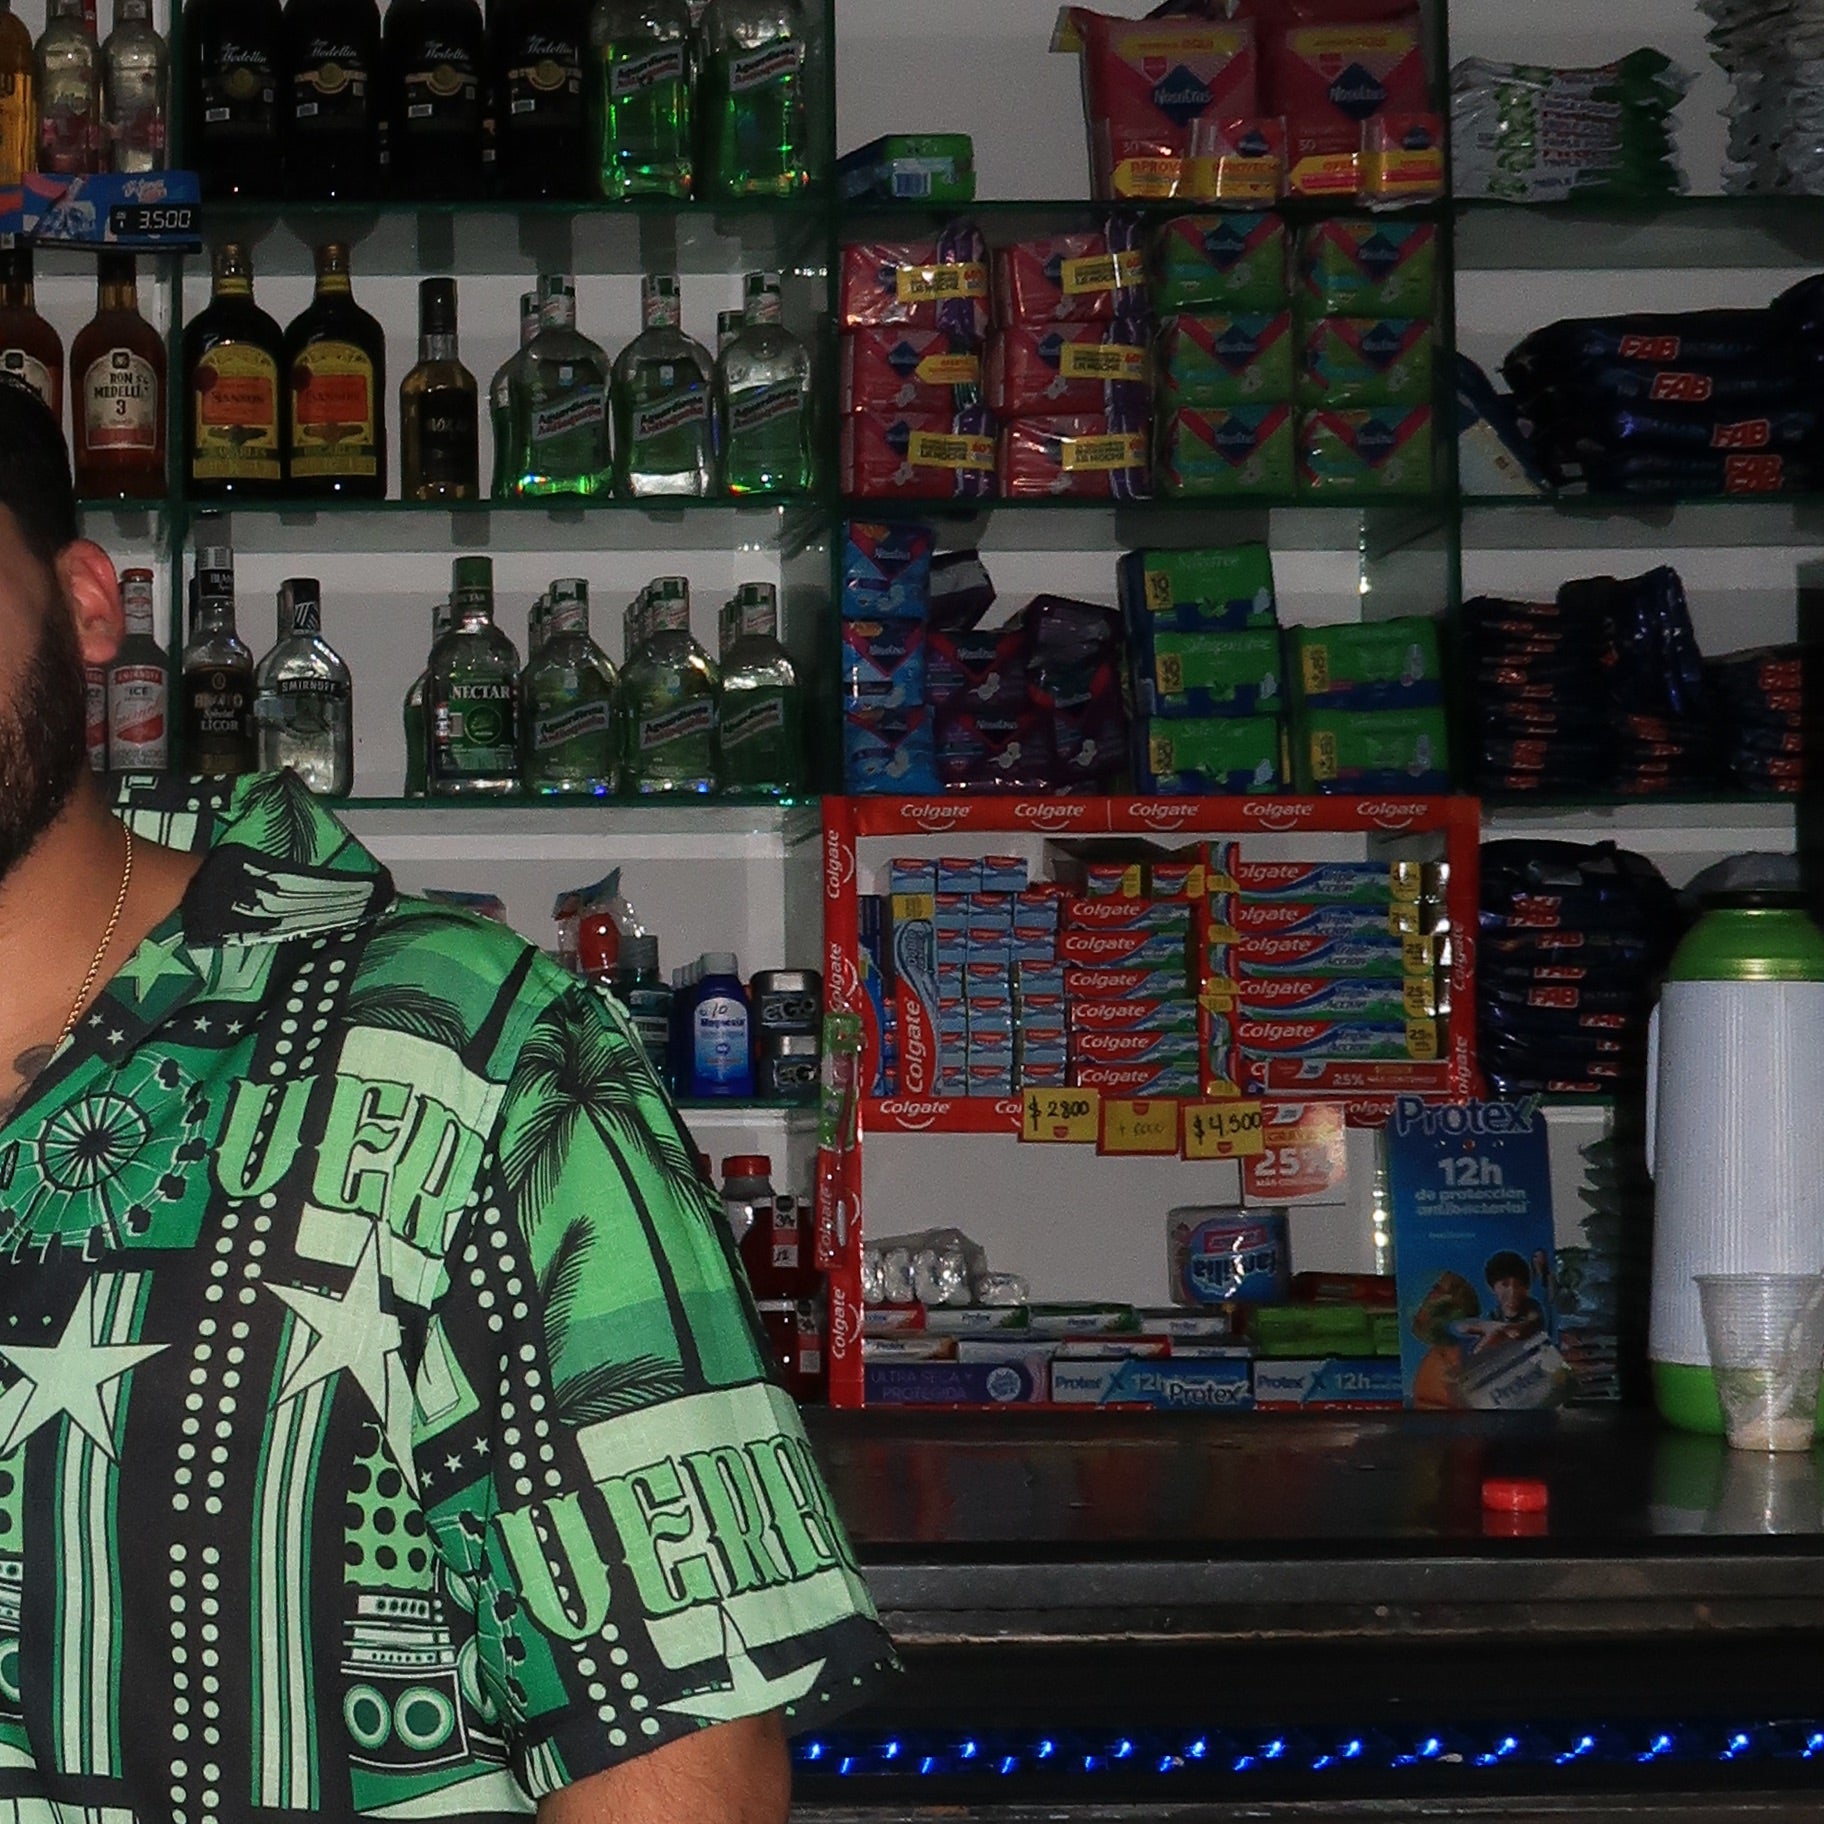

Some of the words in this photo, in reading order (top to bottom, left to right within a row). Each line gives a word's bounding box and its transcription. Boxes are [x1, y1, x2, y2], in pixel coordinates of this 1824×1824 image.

[139, 209, 192, 229] 3.500
[109, 372, 133, 385] RON
[116, 399, 128, 416] 3
[128, 686, 149, 697] ICE
[450, 684, 511, 701] NECTAR
[900, 803, 973, 820] Colgate
[1014, 802, 1087, 820] Colgate
[1128, 802, 1200, 819] Colgate
[1242, 801, 1315, 819] Colgate
[1356, 801, 1428, 819] Colgate
[826, 828, 841, 900] Colgate
[1071, 901, 1142, 919] Colgate
[1064, 935, 1137, 954] Colgate
[1068, 971, 1138, 988] Colgate
[1238, 979, 1313, 998] Colgate
[1076, 1002, 1147, 1020] Colgate
[1238, 1022, 1316, 1041] Colgate
[904, 996, 924, 1094] Colgate
[1080, 1033, 1150, 1052] Colgate
[1081, 1066, 1150, 1085] Colgate
[880, 1099, 952, 1116] Colgate
[1393, 1092, 1543, 1138] Protex
[1437, 1156, 1504, 1187] 12h
[1414, 1188, 1435, 1201] de
[1414, 1200, 1529, 1217] antibacterial
[832, 1285, 847, 1361] Colgate
[1167, 1381, 1252, 1407] Protex
